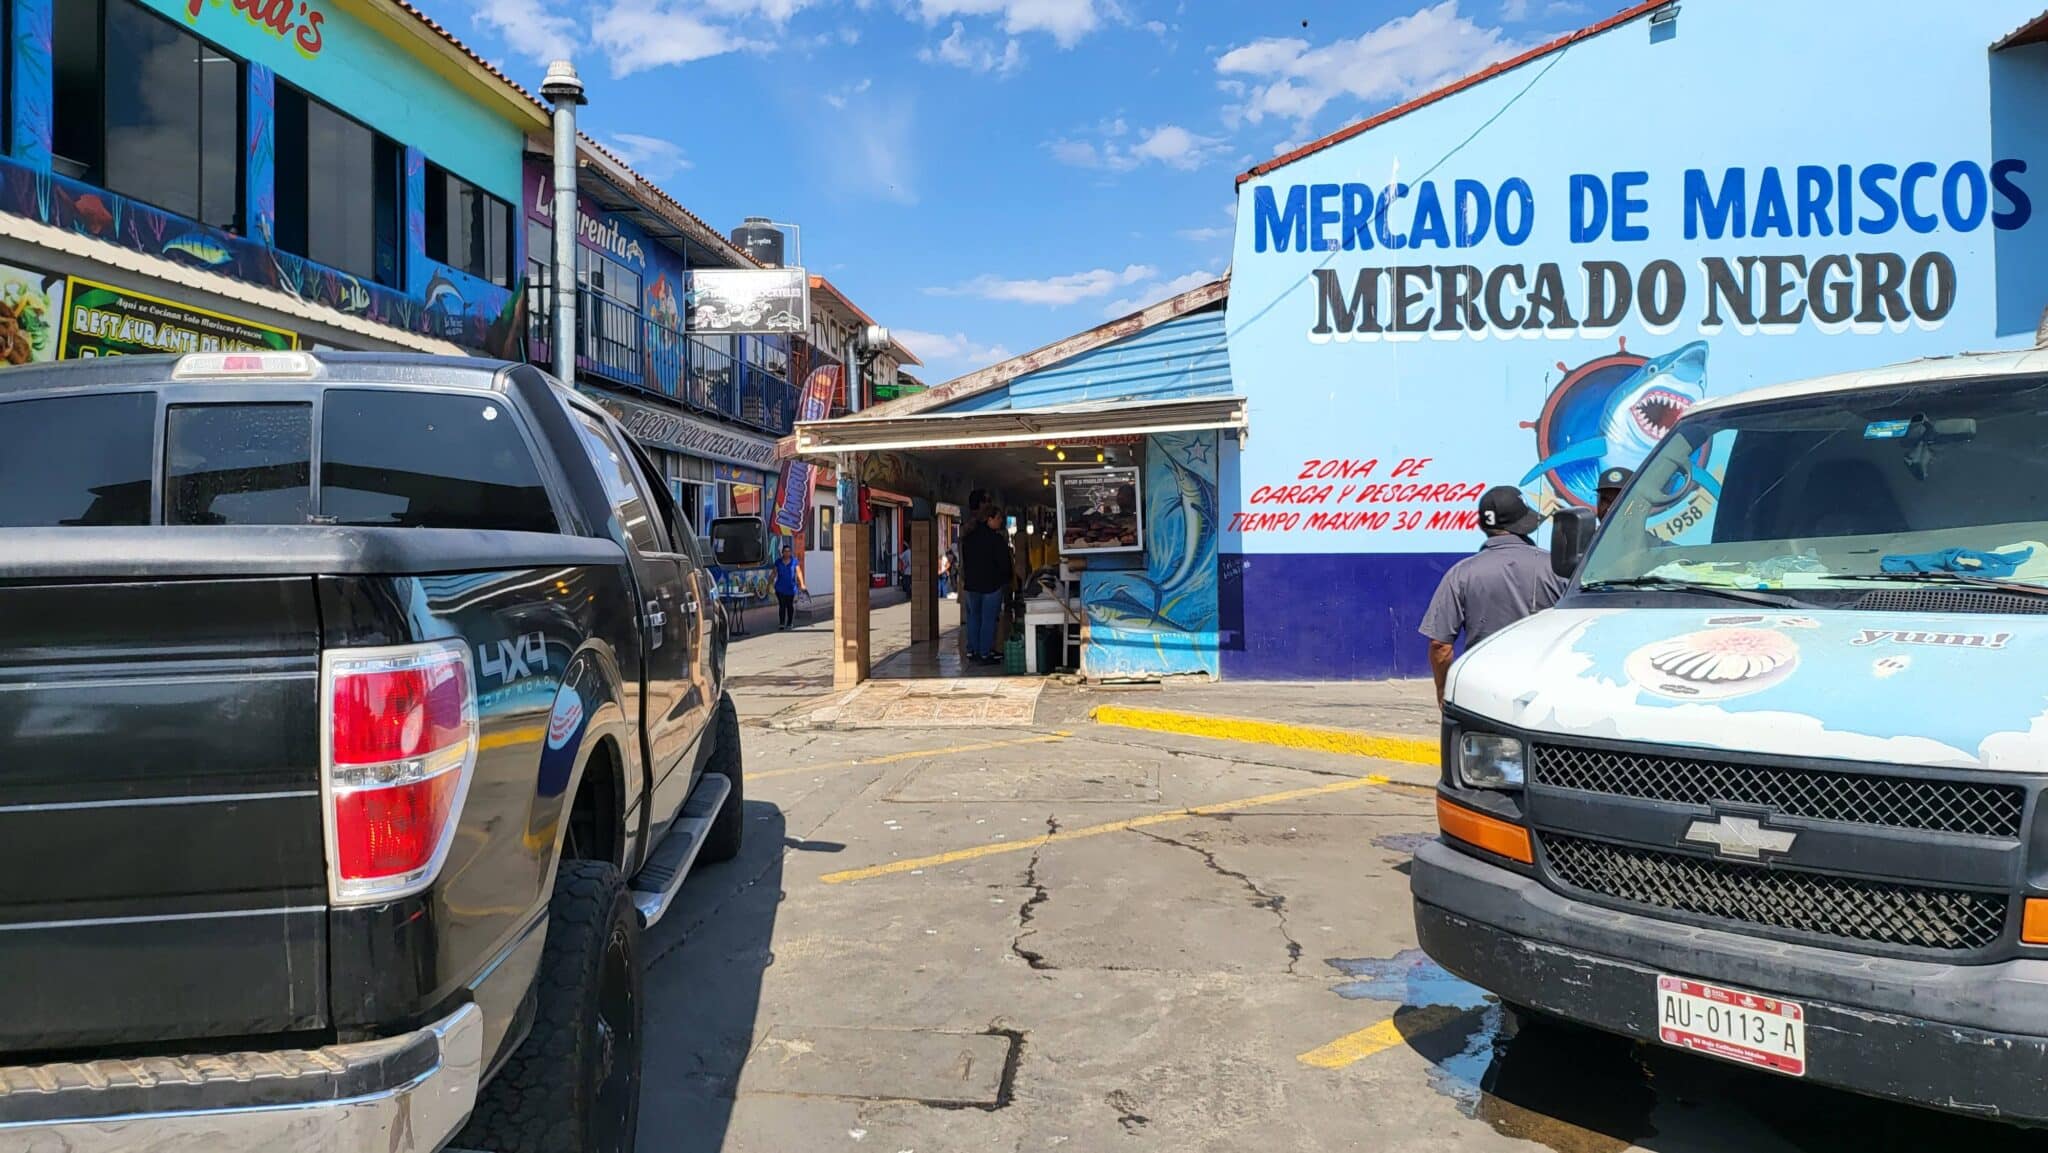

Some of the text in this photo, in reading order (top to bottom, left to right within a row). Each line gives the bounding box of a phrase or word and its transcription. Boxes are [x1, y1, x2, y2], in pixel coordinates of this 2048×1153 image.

[536, 175, 628, 258] L irenita
[1254, 158, 2032, 253] MERCADO DE MARISCOS
[1309, 250, 1957, 336] MERCADO NEGRO
[73, 305, 200, 353] RESTAURANTE
[150, 306, 182, 321] Cocinan
[183, 313, 201, 326] Solo
[201, 318, 234, 334] Mariscos
[235, 326, 263, 340] Frescos
[626, 409, 673, 442] TACOS
[1298, 458, 1433, 479] ZONA DE
[1250, 482, 1486, 504] CARGA Y DESCARGA
[1228, 512, 1300, 532] TIEMPO
[1302, 511, 1390, 532] MAXIMO
[1392, 511, 1422, 531] 30
[1484, 510, 1496, 526] 3
[1665, 505, 1704, 537] 1958
[1852, 630, 2009, 648] yum!
[478, 630, 550, 685] 4X4
[484, 674, 551, 708] OFF ROAD
[1665, 995, 1797, 1054] AU-0113-A
